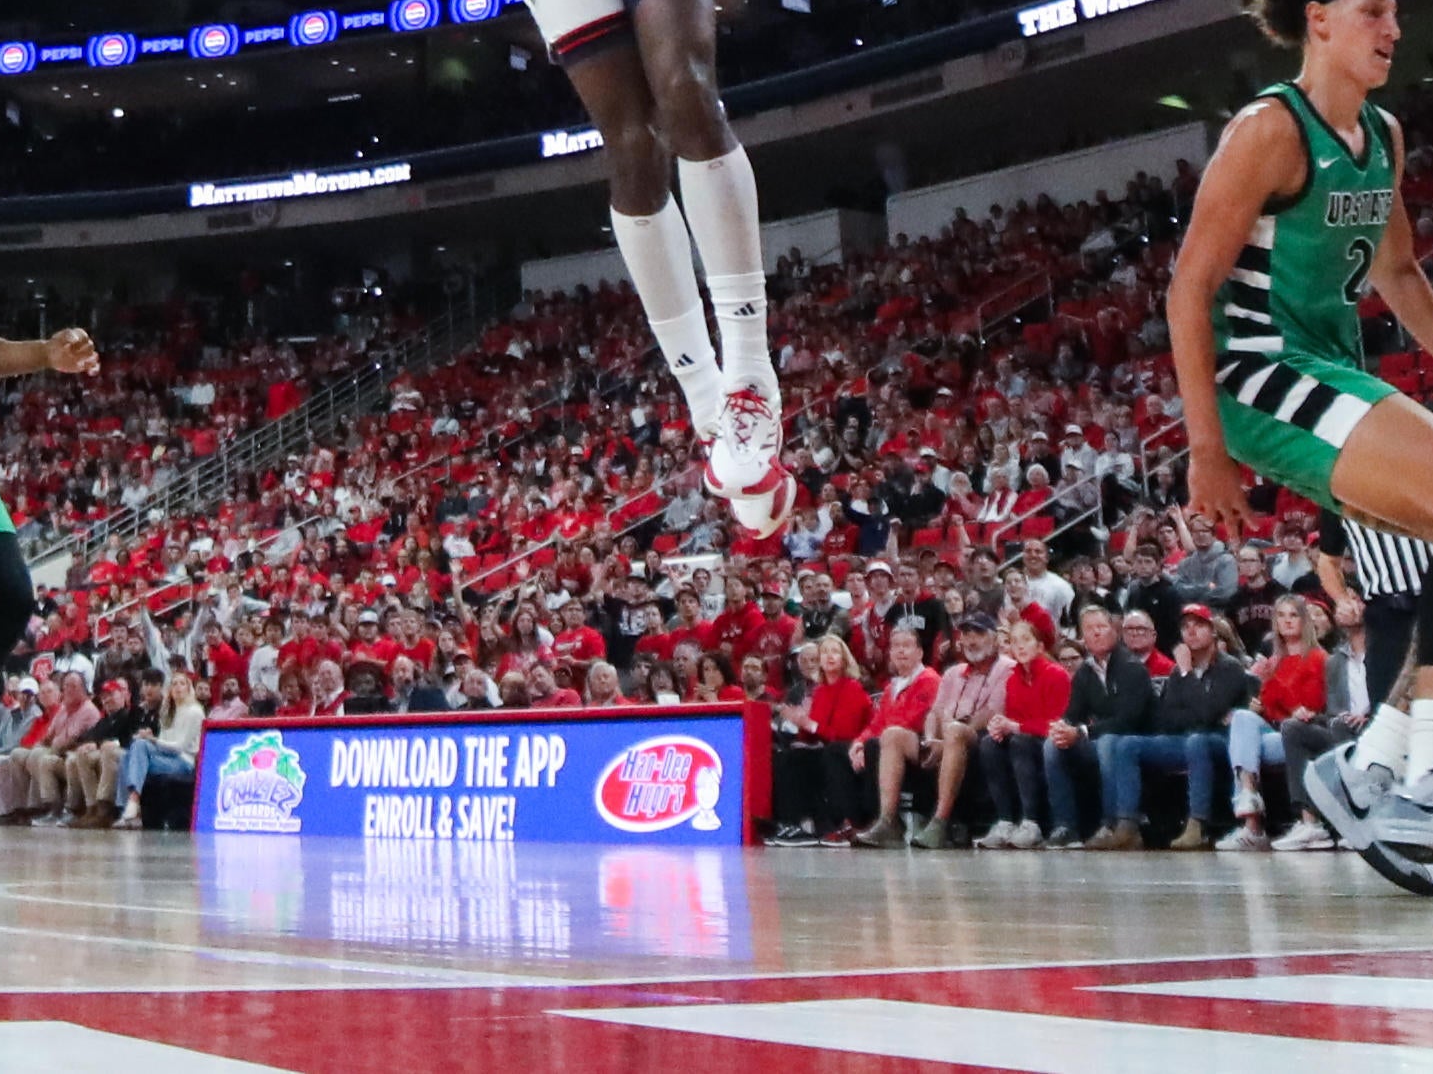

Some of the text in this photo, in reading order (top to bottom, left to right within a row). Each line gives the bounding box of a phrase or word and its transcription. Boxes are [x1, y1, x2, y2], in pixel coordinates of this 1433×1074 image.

[244, 28, 285, 45] PEPSI
[343, 12, 385, 29] PEPSI
[41, 47, 83, 61] PEPSI
[141, 38, 184, 54] PEPSI
[1341, 236, 1375, 305] 2
[330, 734, 567, 788] DOWNLOAD THE APP
[619, 747, 693, 782] Han-Dee
[364, 794, 516, 840] ENROLL & SAVE!
[623, 783, 686, 818] Hugo's
